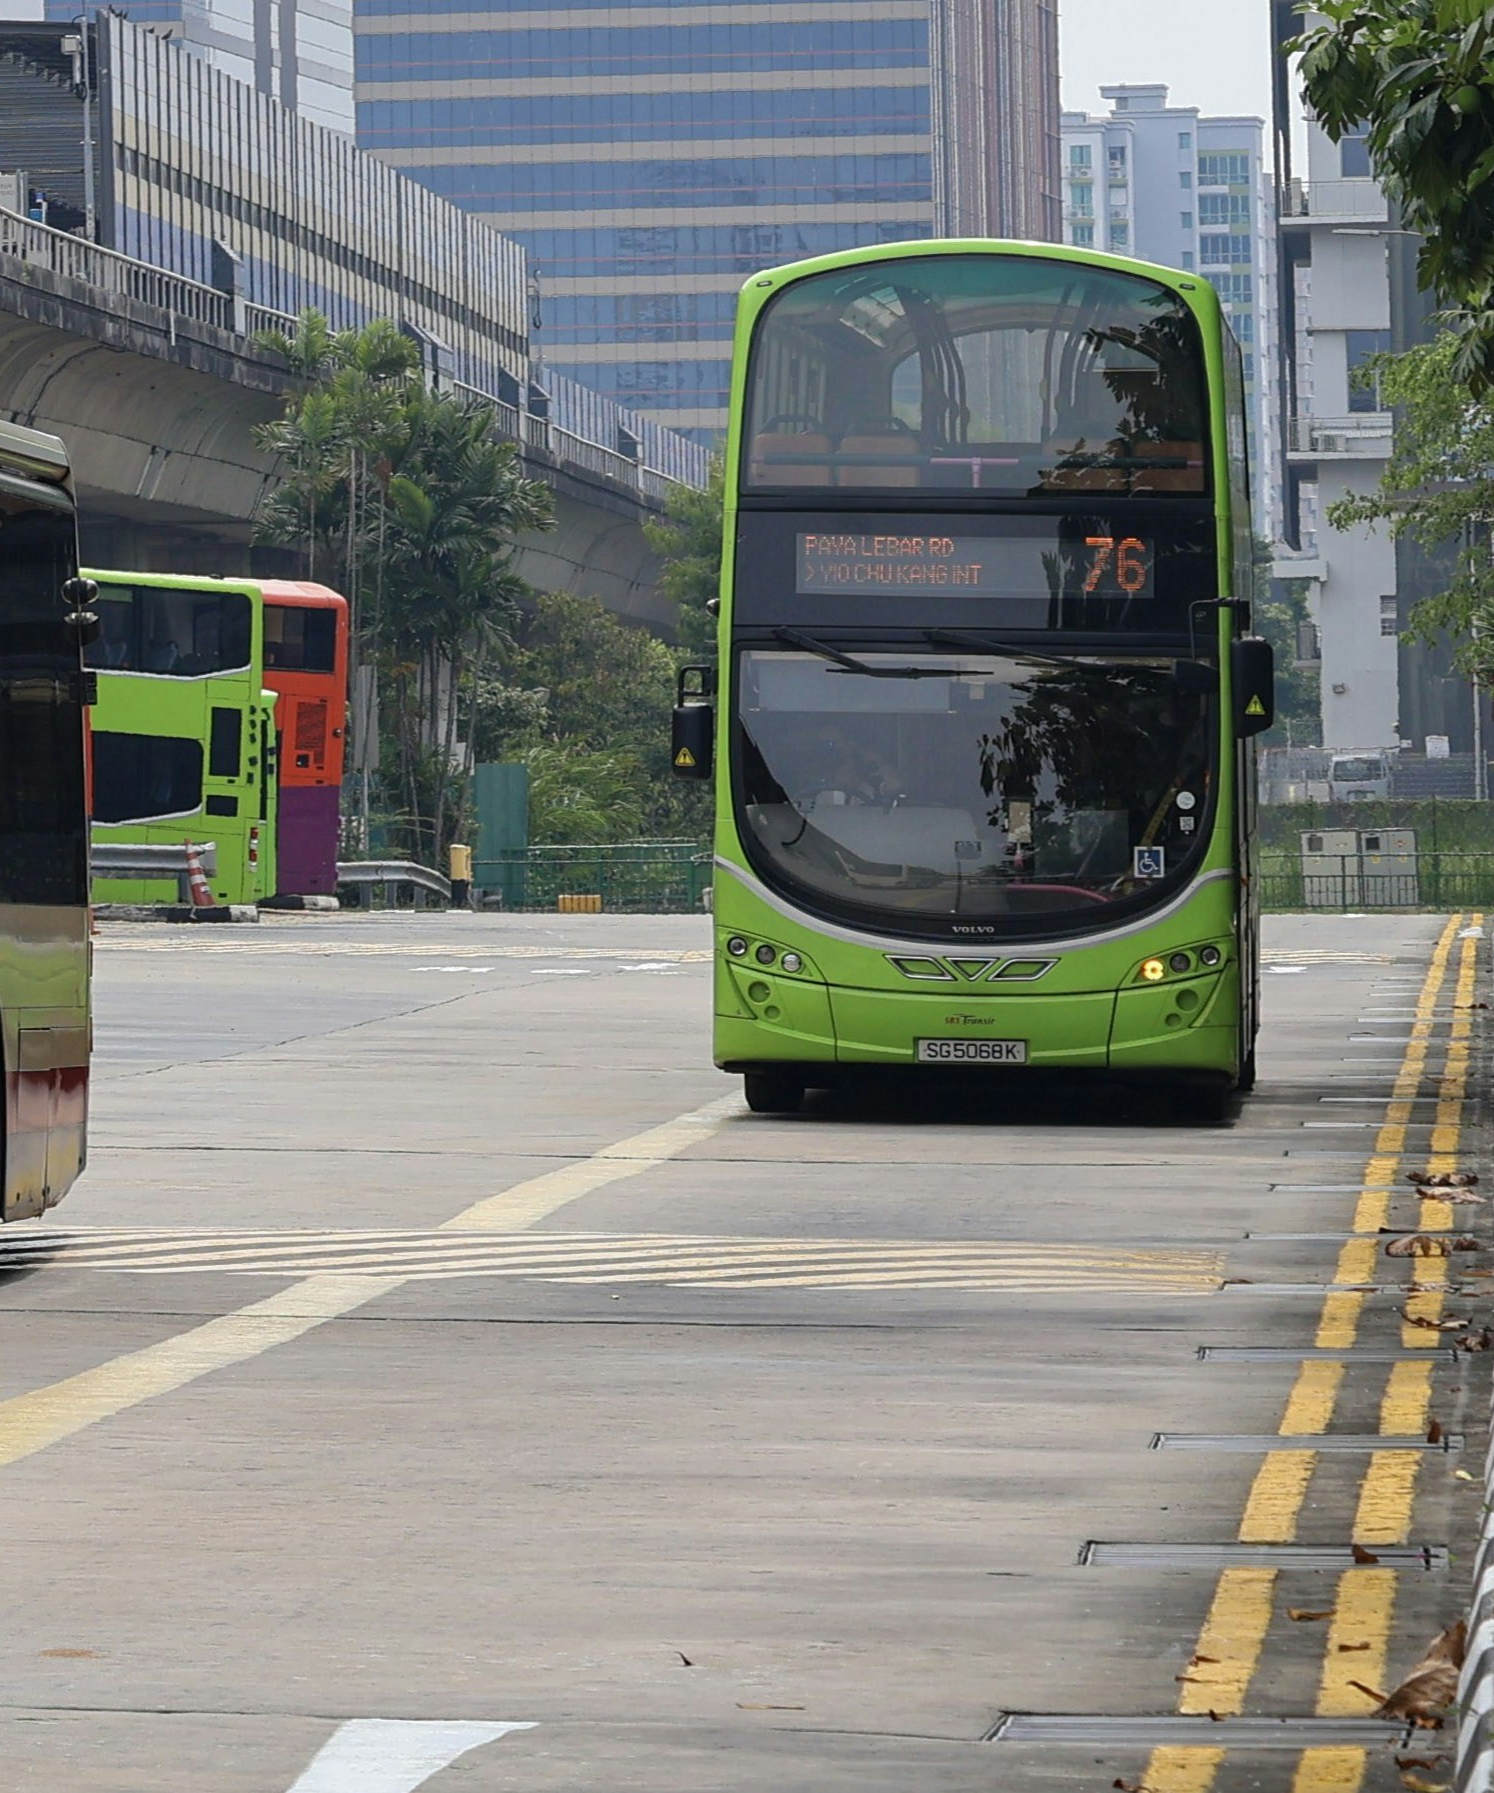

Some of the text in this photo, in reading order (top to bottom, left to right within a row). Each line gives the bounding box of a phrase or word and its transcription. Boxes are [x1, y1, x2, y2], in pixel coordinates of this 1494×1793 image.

[805, 535, 955, 558] PAYA LEBAR RD
[820, 563, 982, 585] YIO CHU KANG INT
[1085, 536, 1147, 592] 76
[951, 926, 995, 934] VOLVO
[960, 1014, 996, 1026] Transit
[926, 1042, 1018, 1060] SG5068K
